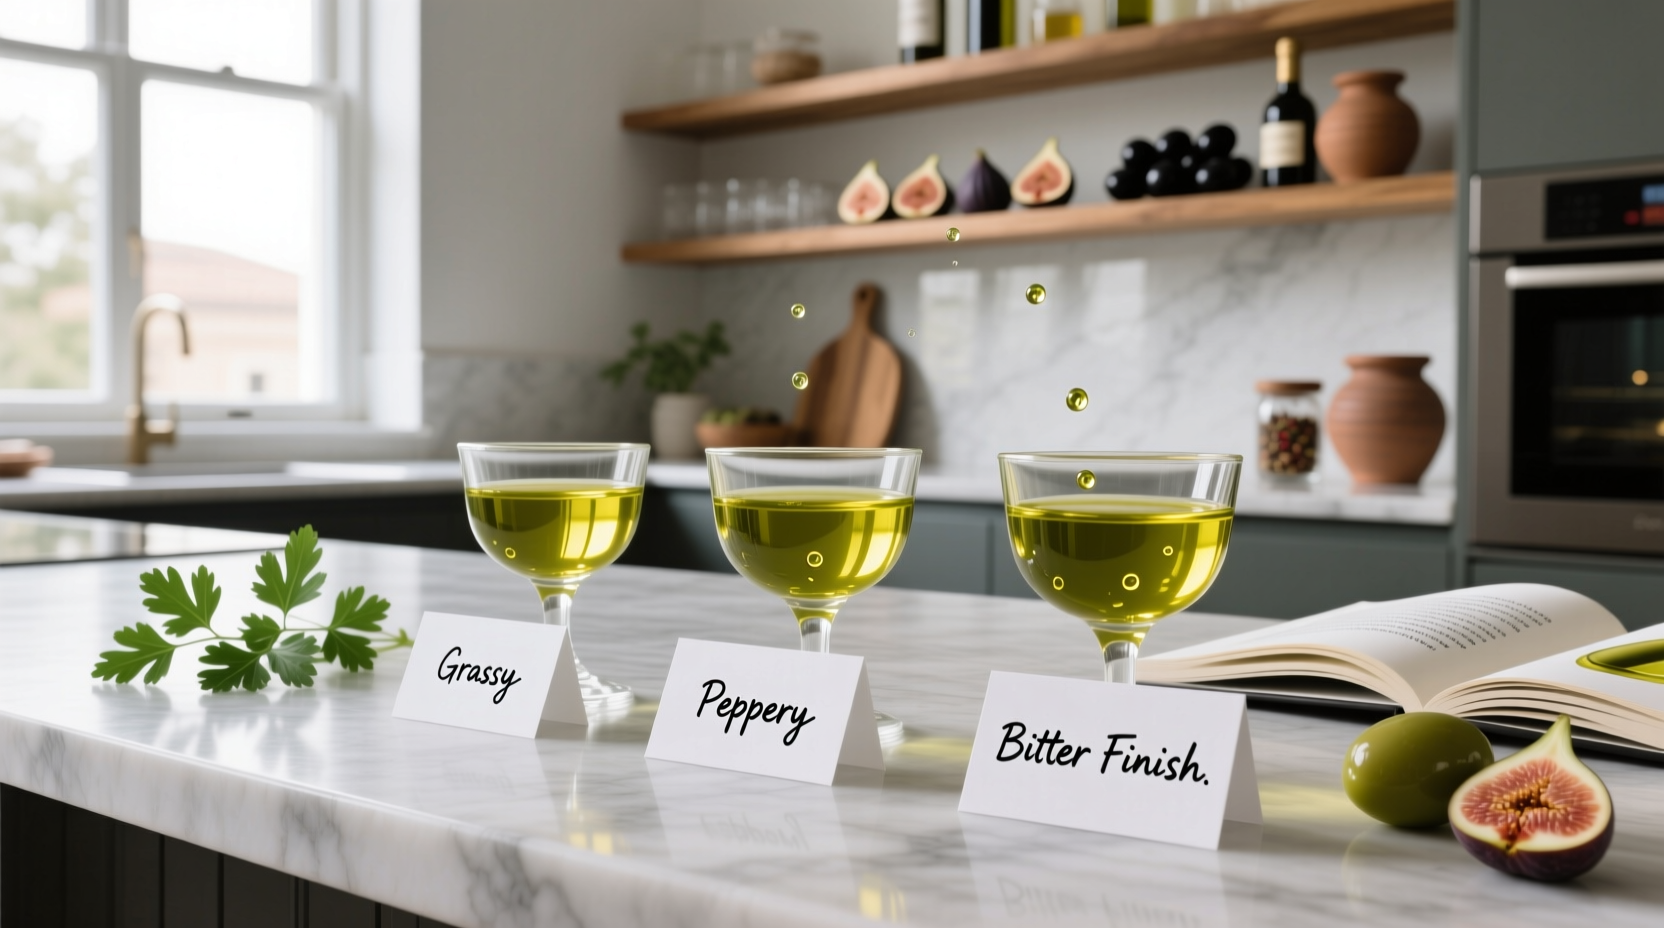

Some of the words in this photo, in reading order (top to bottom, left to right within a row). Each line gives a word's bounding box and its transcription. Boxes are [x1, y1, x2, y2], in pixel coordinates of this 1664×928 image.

[437, 646, 522, 705] Grassy
[696, 679, 816, 747] Peppery
[996, 721, 1092, 768] Bitter
[1100, 733, 1209, 786] Finish.
